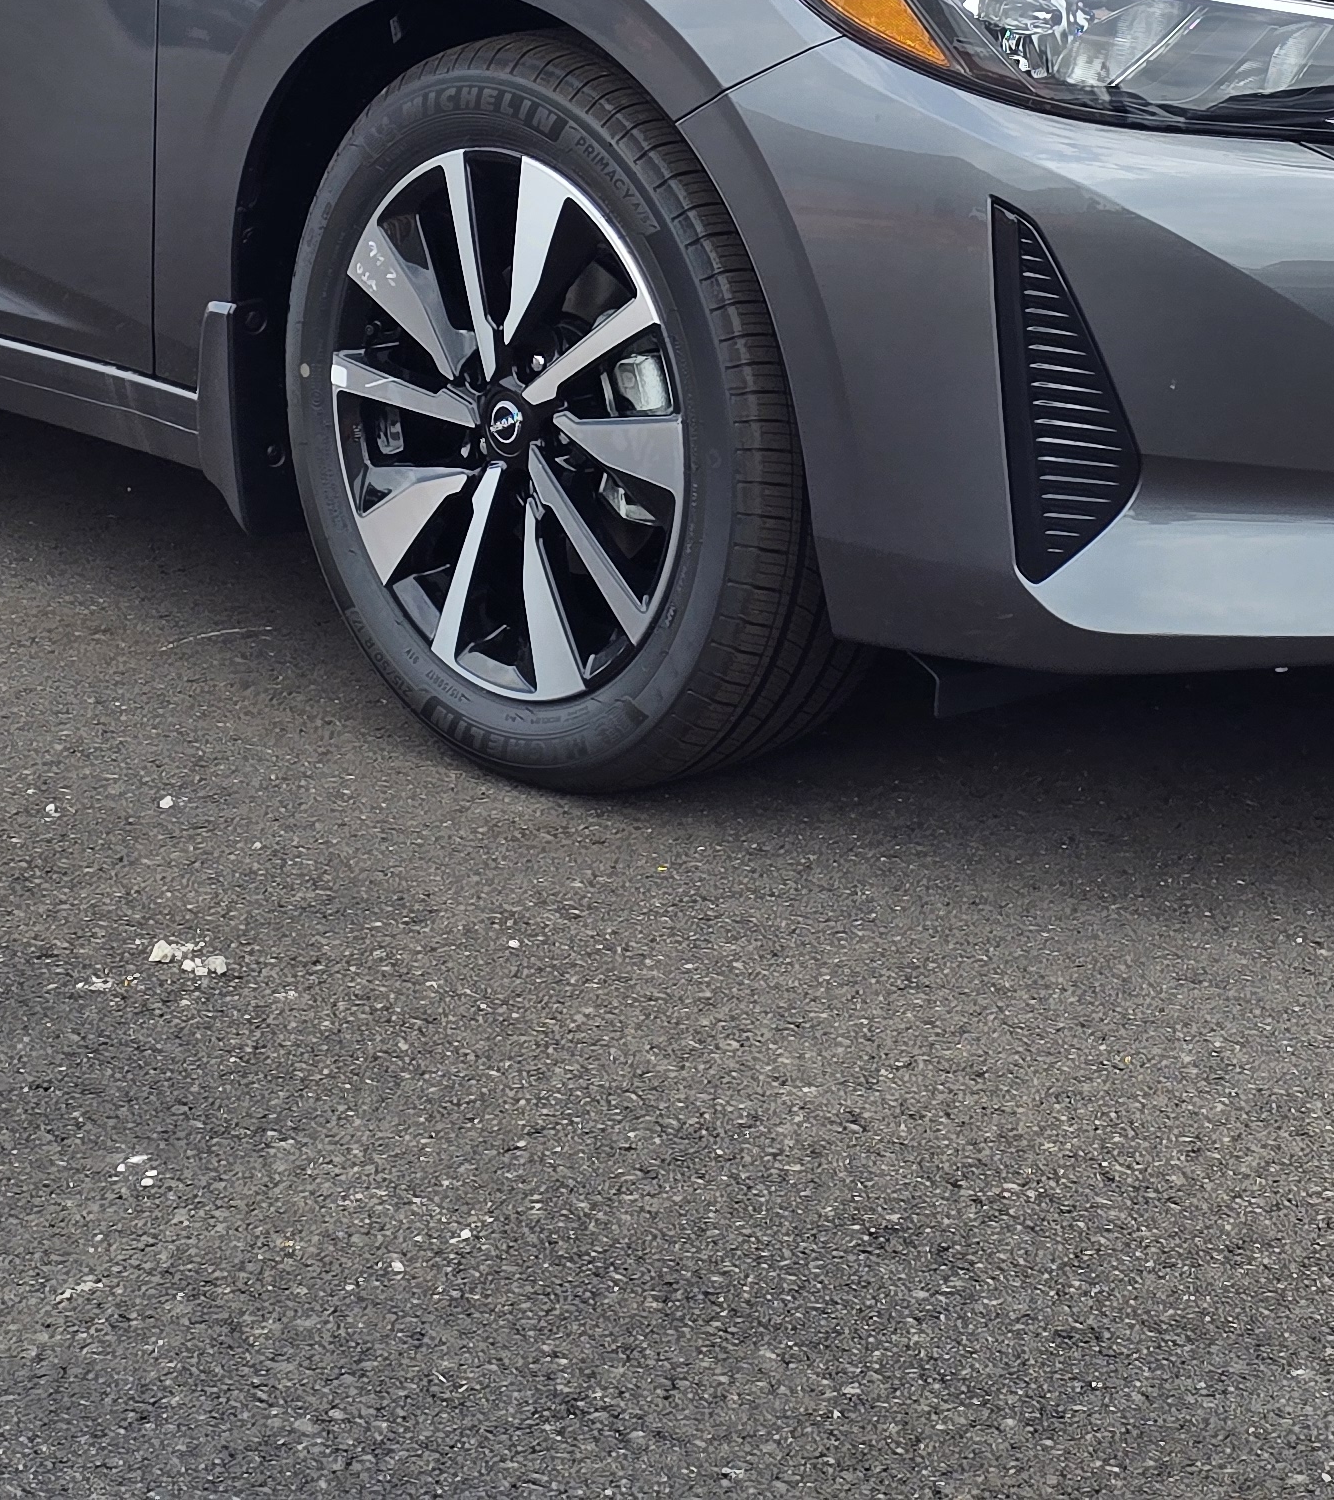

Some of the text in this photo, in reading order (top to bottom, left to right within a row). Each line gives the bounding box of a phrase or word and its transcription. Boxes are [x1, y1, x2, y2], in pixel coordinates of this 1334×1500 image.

[402, 87, 557, 133] MICHELIN
[575, 135, 635, 199] PRIMACY
[365, 639, 376, 650] R
[373, 653, 413, 698] 215/50
[425, 669, 466, 702] 215/50R17
